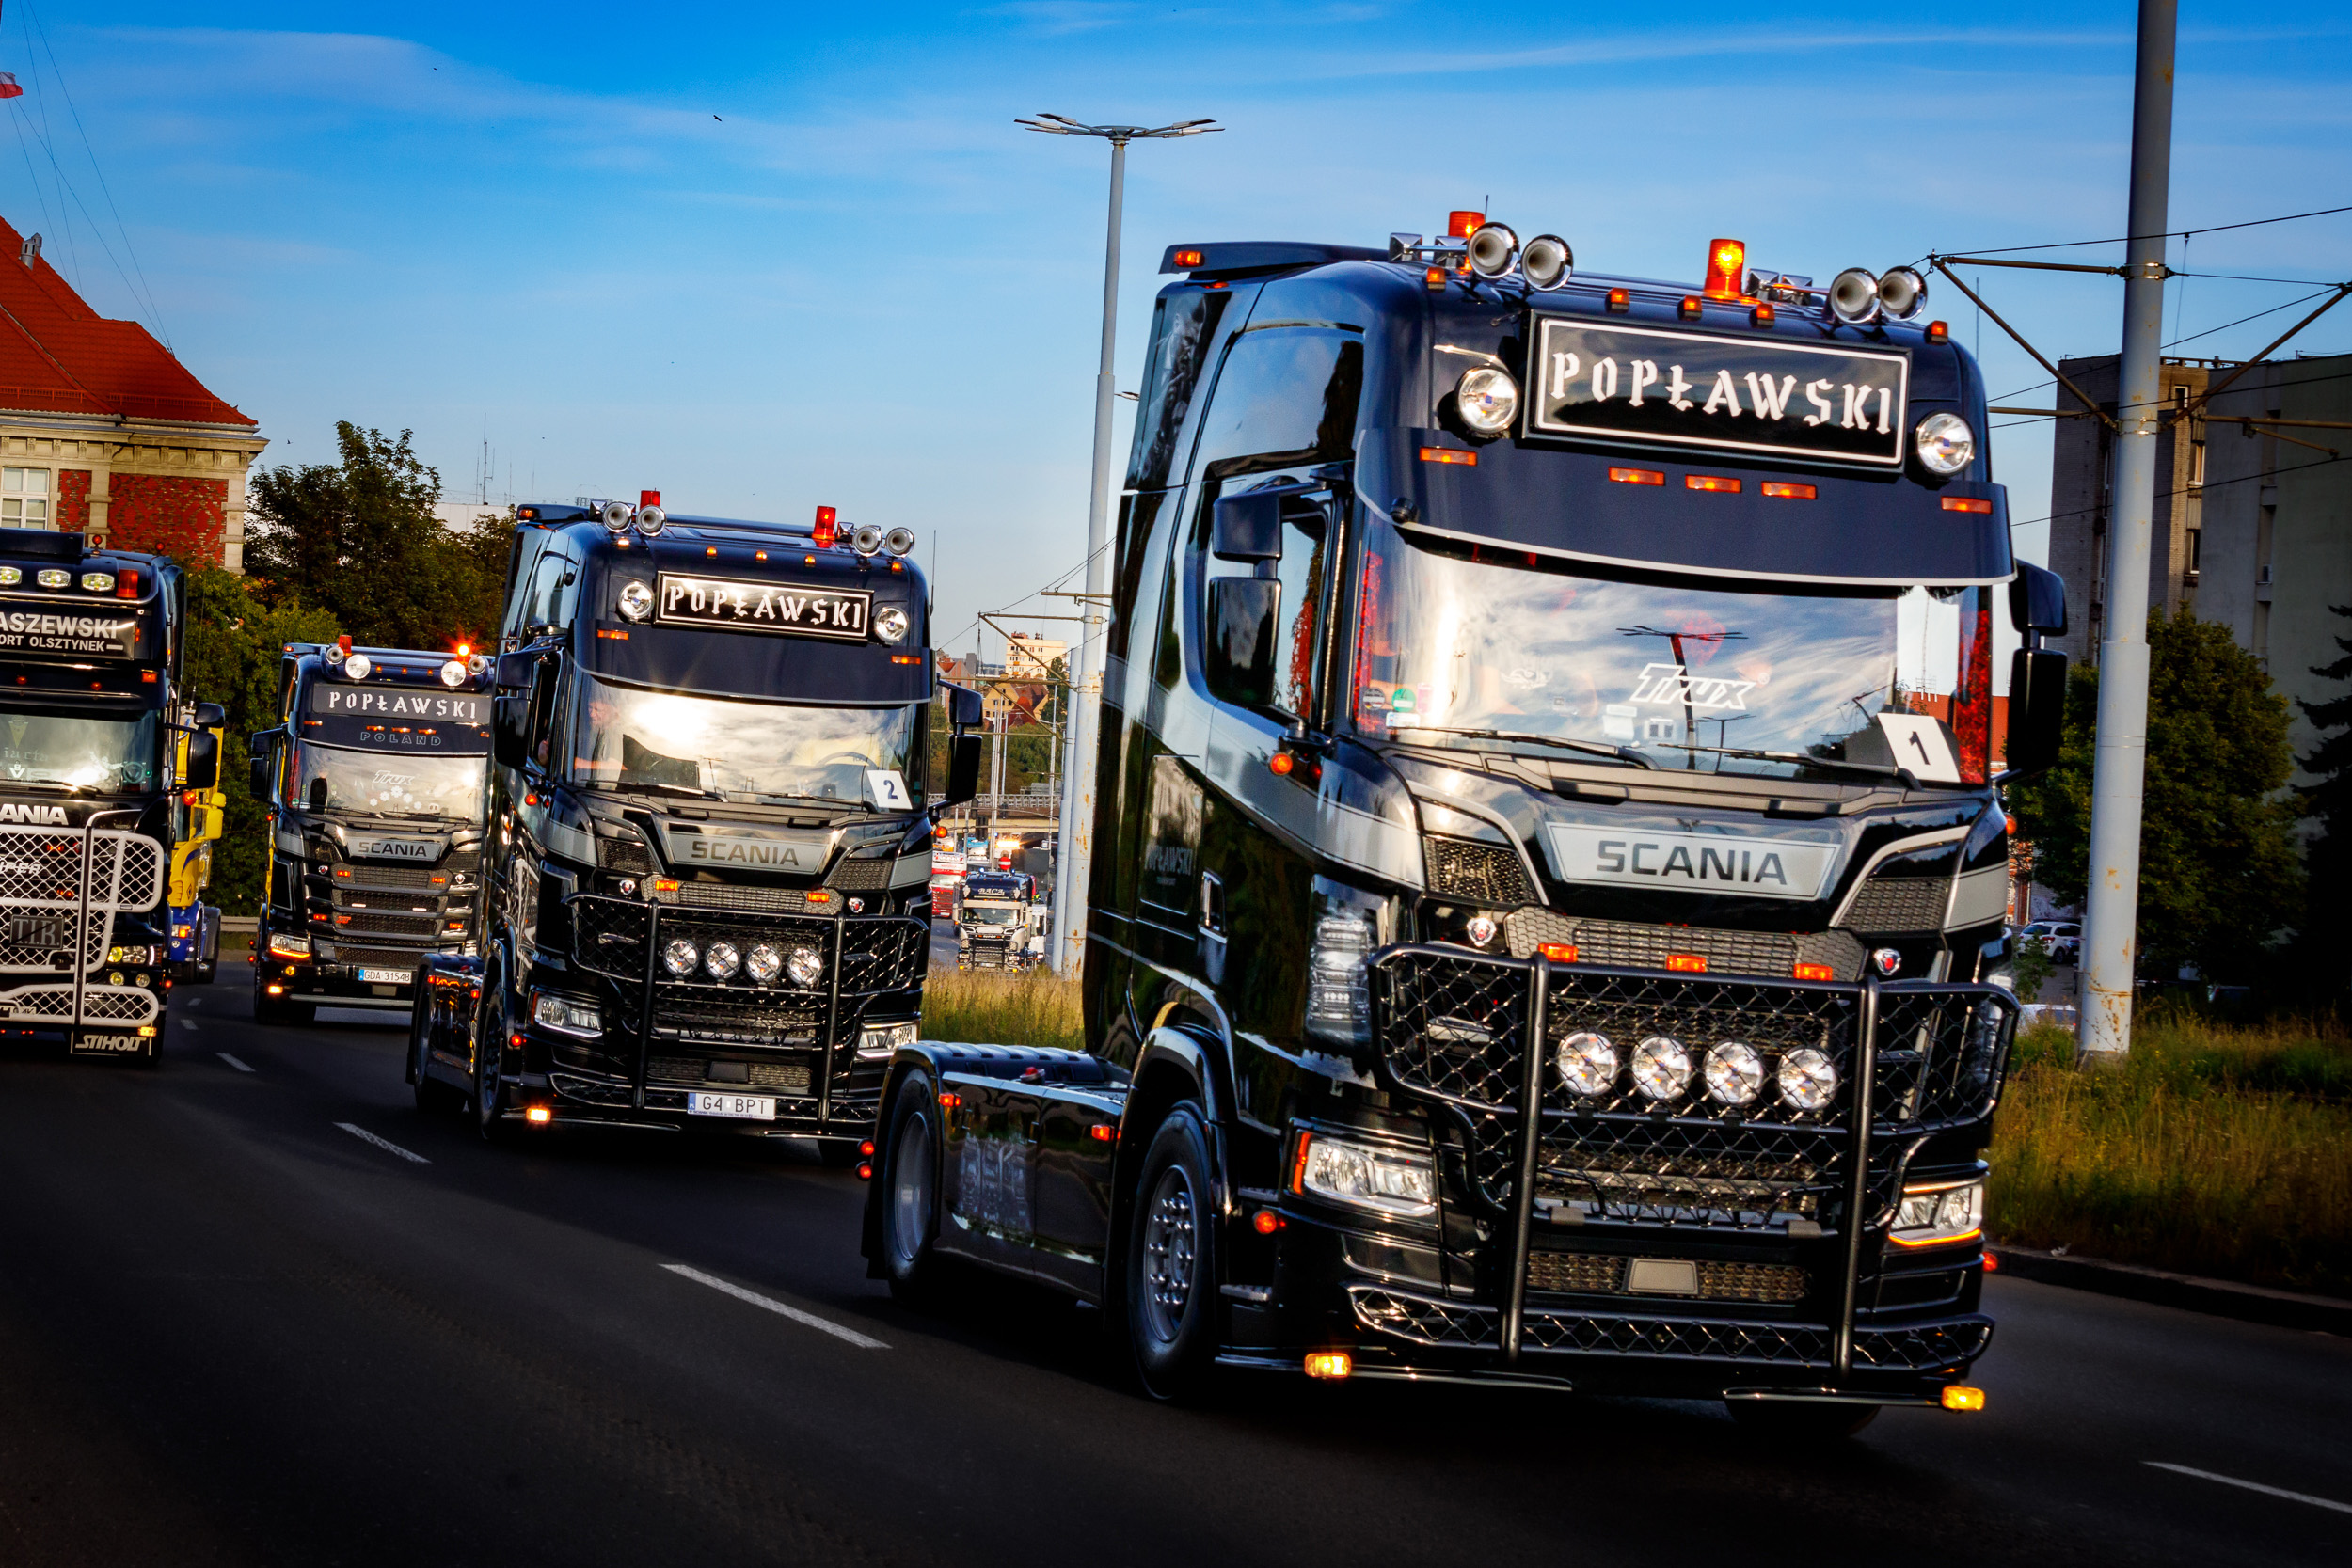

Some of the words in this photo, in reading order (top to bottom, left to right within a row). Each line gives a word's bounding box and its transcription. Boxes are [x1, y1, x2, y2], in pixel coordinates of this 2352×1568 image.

[1550, 351, 1892, 435] POPŁAWSKI
[669, 586, 861, 627] POPŁAWSKI
[0, 612, 118, 639] ASZEWSKI
[29, 636, 104, 652] OLSZTYNEK
[329, 691, 476, 719] POPŁAWSKI
[360, 732, 442, 746] POLAND
[1908, 731, 1931, 766] 1
[882, 779, 898, 800] 2
[0, 803, 69, 826] ANIA
[358, 841, 427, 857] SCANIA
[691, 840, 800, 867] SCANIA
[1596, 839, 1788, 886] SCANIA
[14, 918, 60, 946] T.I.R.
[364, 971, 382, 981] GDA
[384, 972, 411, 983] 31548
[703, 1096, 723, 1111] G4
[735, 1098, 767, 1114] BPT
